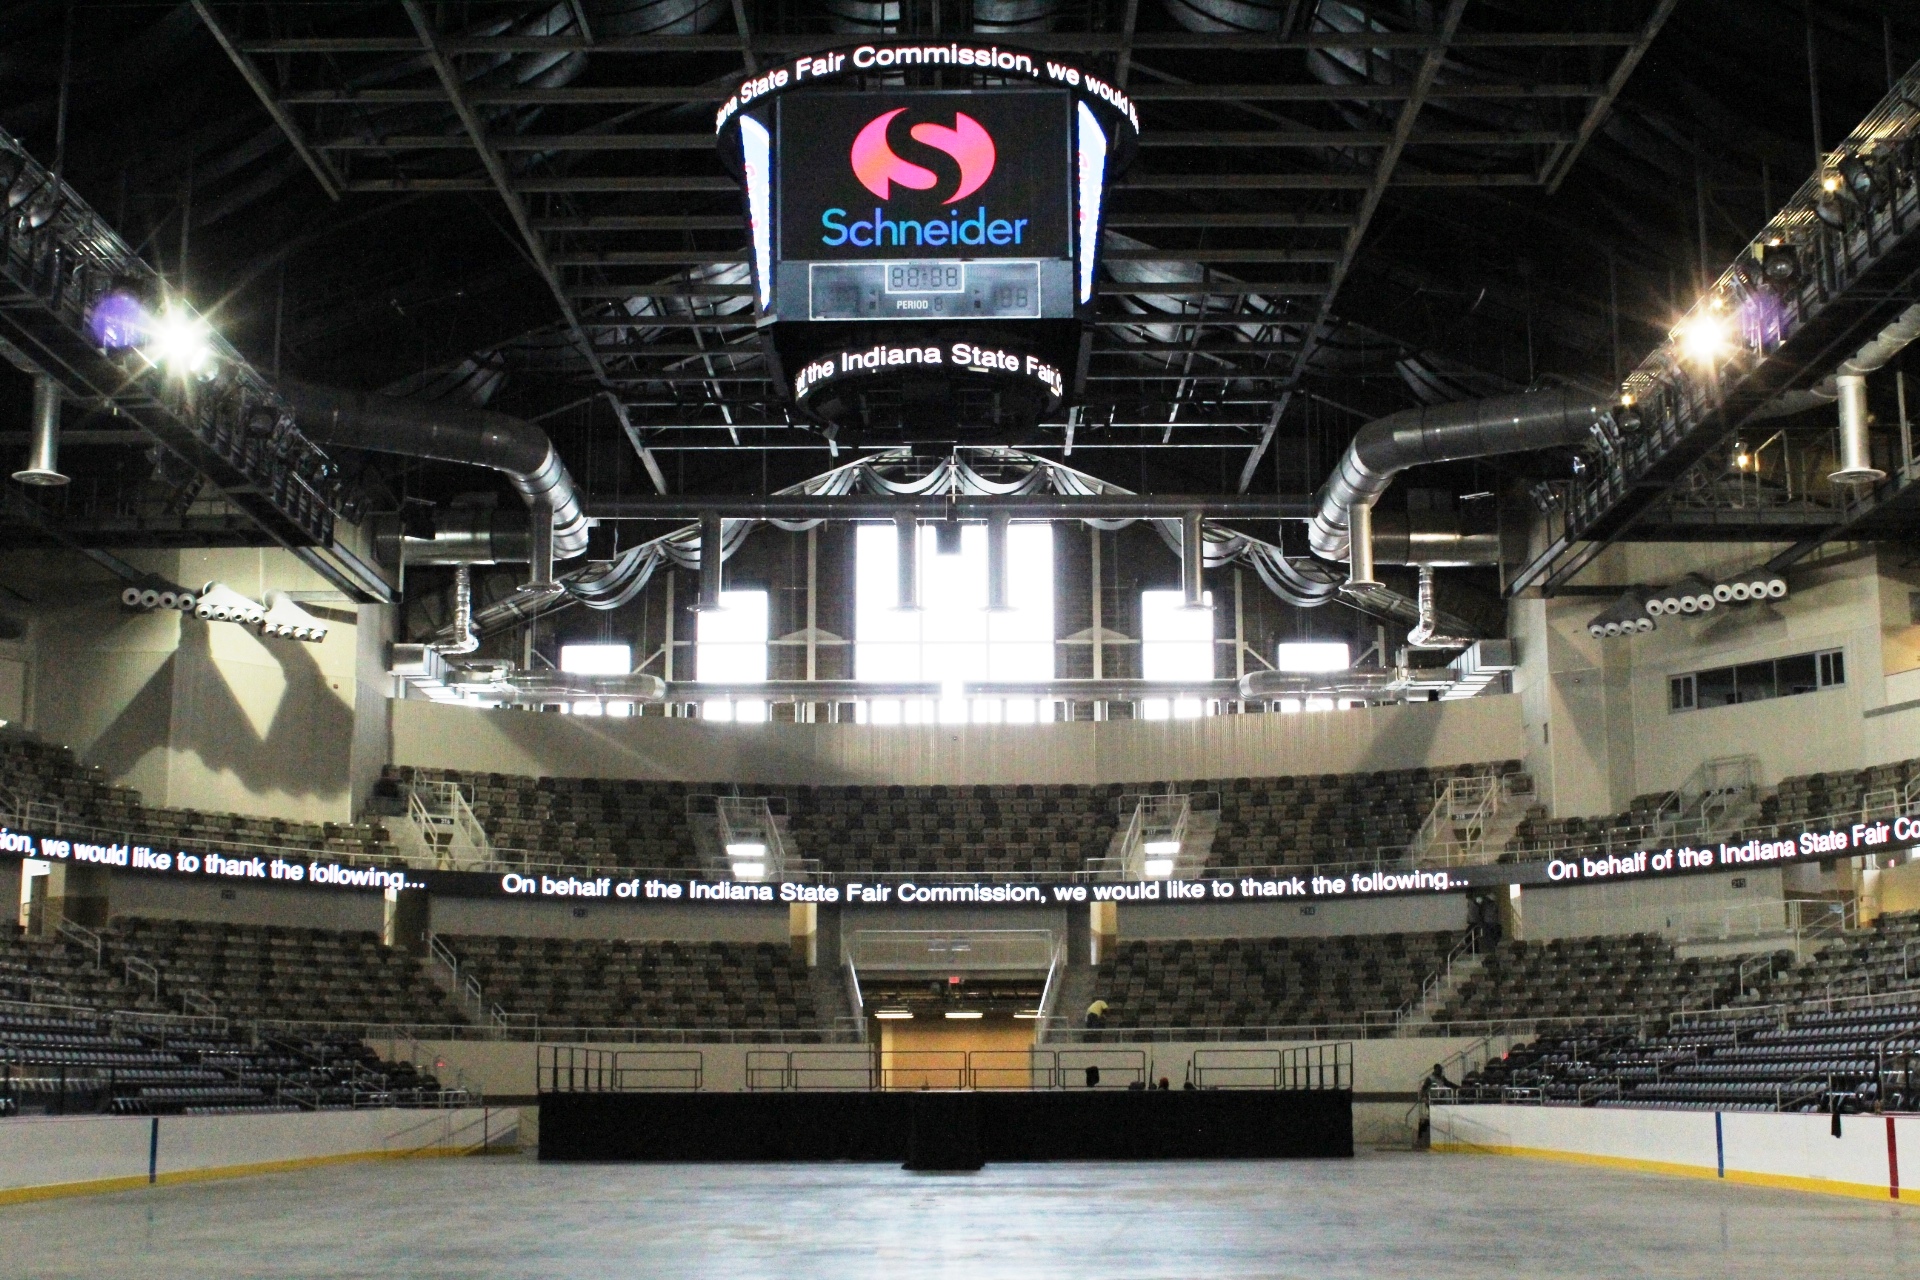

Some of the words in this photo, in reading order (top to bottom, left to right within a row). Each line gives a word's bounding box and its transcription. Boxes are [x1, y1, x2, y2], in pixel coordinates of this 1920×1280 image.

[741, 70, 788, 103] State
[797, 53, 845, 80] Fair
[853, 44, 1038, 76] Commission,
[1047, 62, 1079, 85] we
[1084, 74, 1128, 115] would
[822, 206, 1028, 248] Schneider
[896, 300, 929, 310] PERIOD
[807, 361, 834, 383] the
[842, 346, 942, 373] Indiana
[952, 344, 1019, 372] State
[1027, 356, 1055, 385] Fair
[0, 828, 35, 856] ion,
[41, 839, 69, 858] we
[74, 844, 127, 865] would
[133, 847, 171, 870] like
[177, 852, 199, 872] to
[205, 854, 265, 877] thank
[270, 859, 303, 880] the
[308, 861, 425, 890] following...
[1548, 858, 1577, 880] On
[1582, 852, 1647, 877] behalf
[1652, 849, 1672, 870] of
[1678, 847, 1713, 867] the
[1720, 840, 1796, 863] Indiana
[1800, 831, 1847, 854] State
[1852, 822, 1889, 846] Fair
[502, 874, 535, 893] On
[542, 876, 610, 896] behalf
[616, 879, 639, 897] of
[645, 880, 681, 898] the
[690, 880, 774, 901] Indiana
[780, 882, 839, 902] State
[847, 884, 891, 901] Fair
[898, 883, 1046, 903] Commission,
[1054, 887, 1086, 901] we
[1094, 881, 1159, 900] would
[1167, 879, 1206, 899] like
[1212, 880, 1234, 897] to
[1240, 877, 1305, 896] thank
[1312, 876, 1346, 894] the
[1352, 870, 1468, 892] following...
